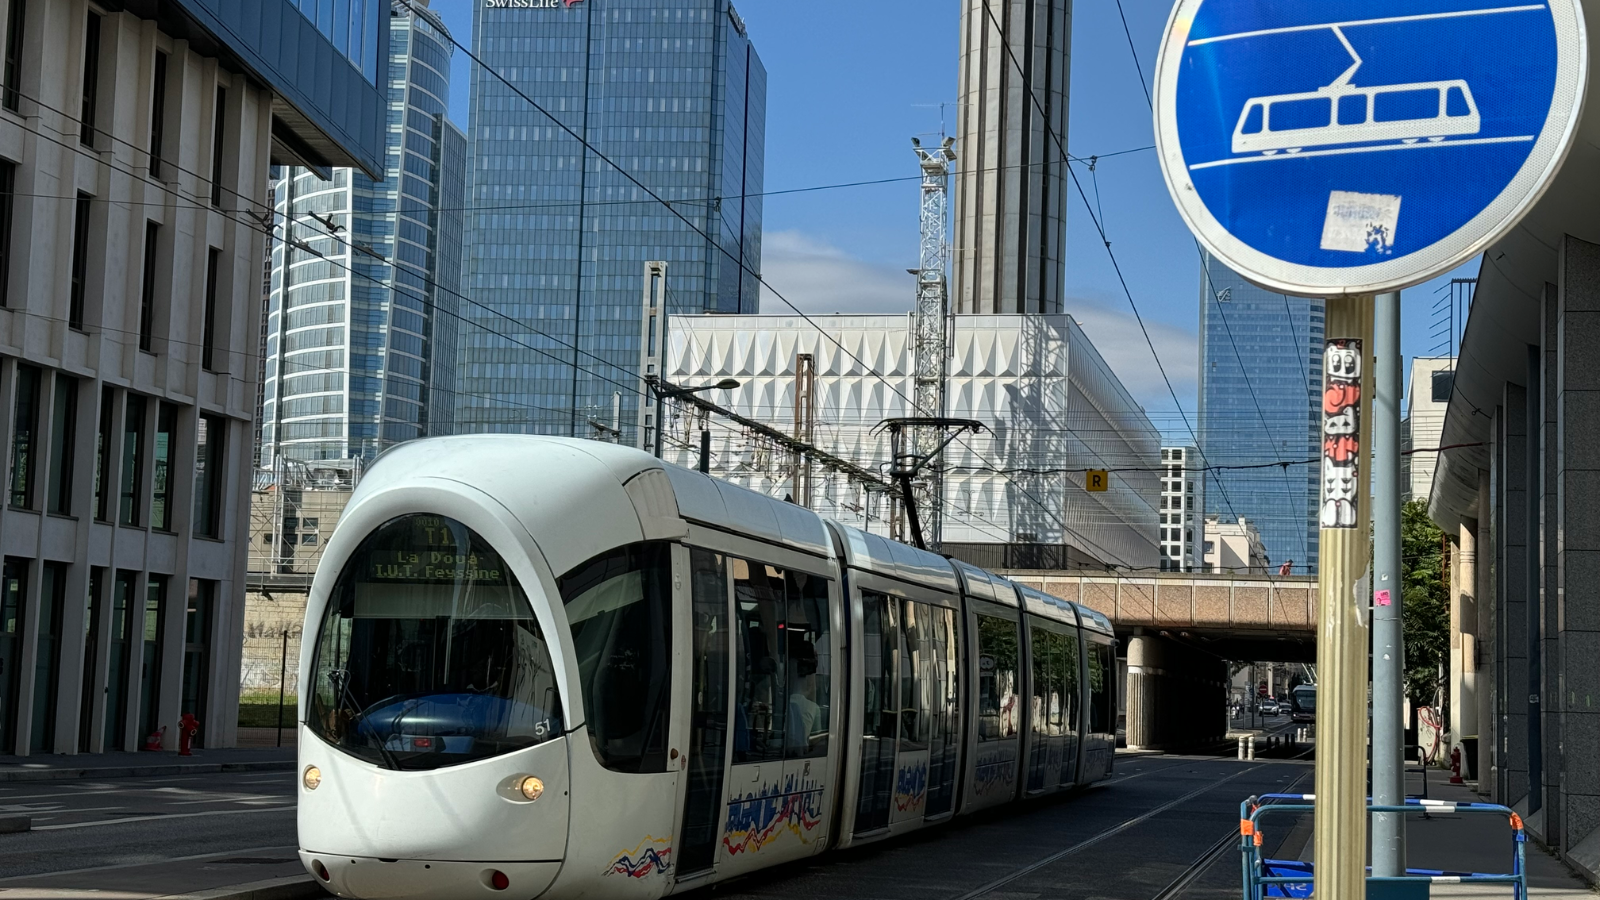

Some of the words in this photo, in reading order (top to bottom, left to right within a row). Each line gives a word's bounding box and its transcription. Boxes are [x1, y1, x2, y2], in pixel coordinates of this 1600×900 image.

[1092, 474, 1102, 487] R
[424, 527, 450, 544] T1
[397, 550, 419, 563] La
[425, 565, 500, 579] Feyssine
[534, 718, 551, 736] 51
